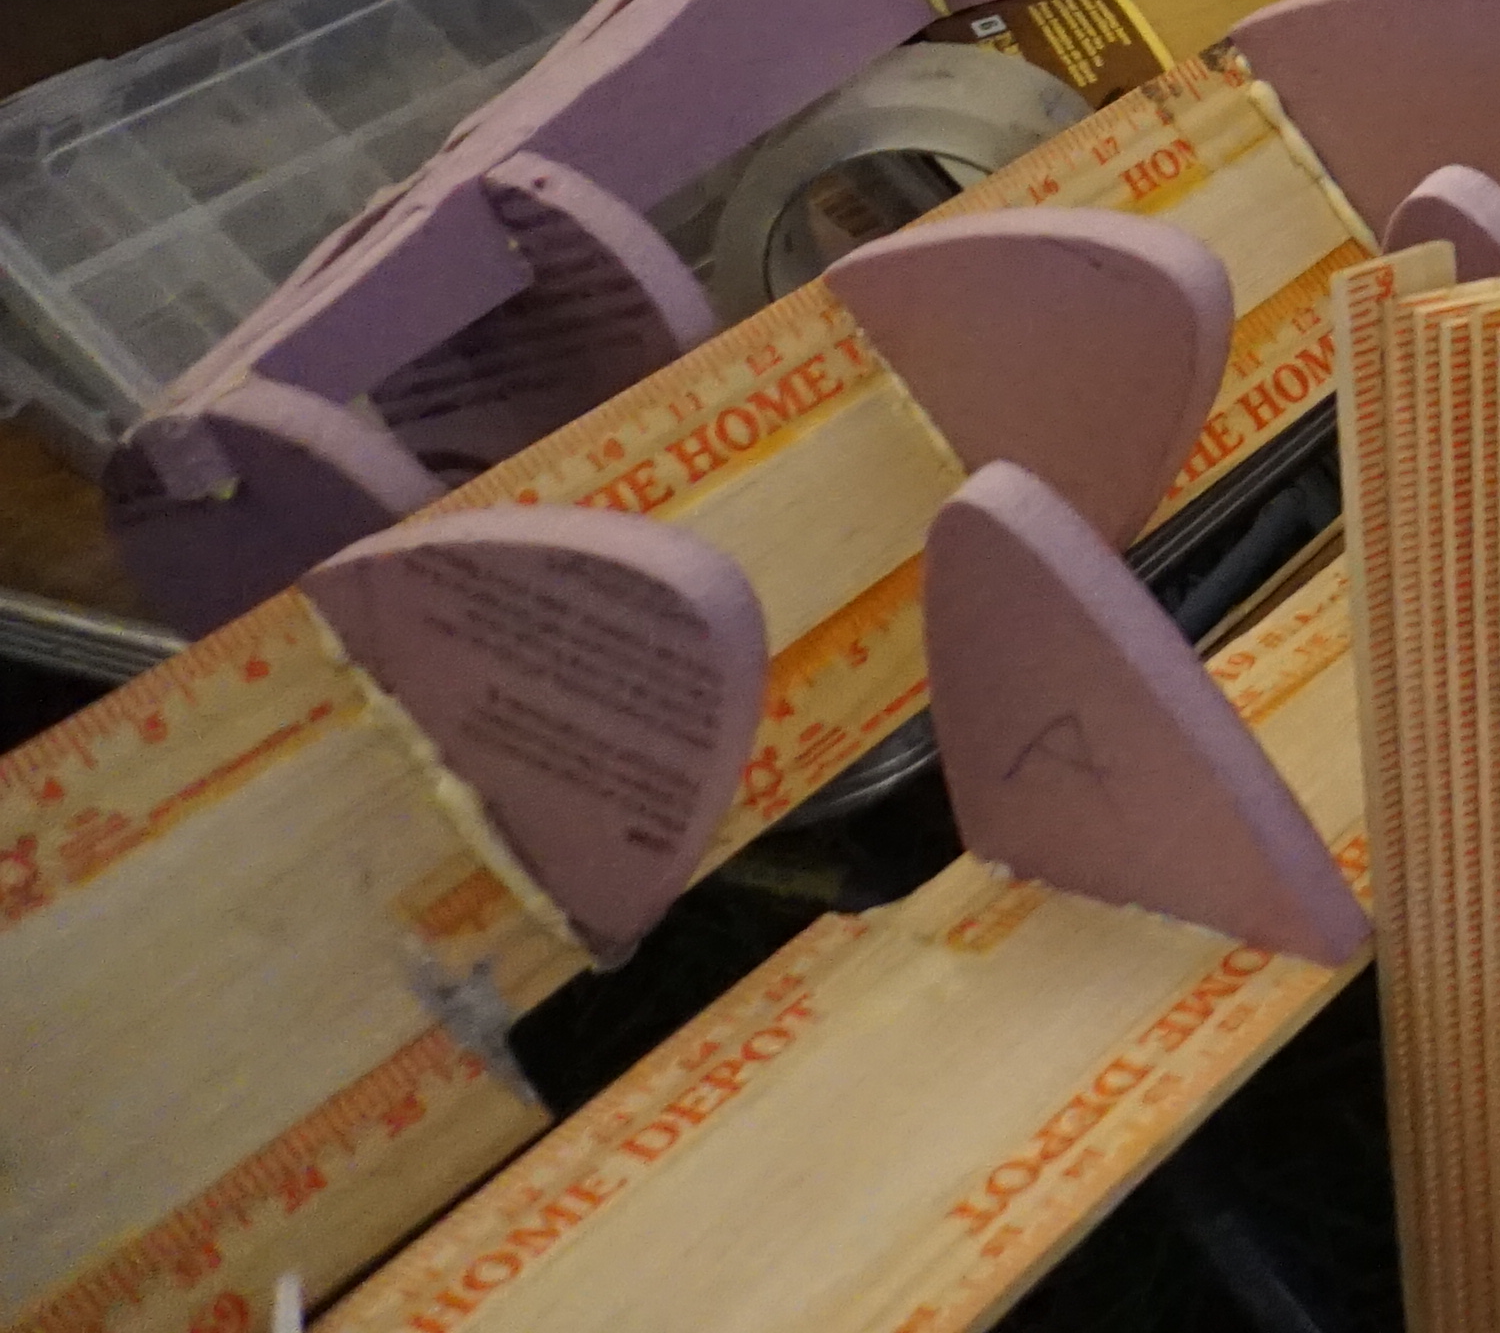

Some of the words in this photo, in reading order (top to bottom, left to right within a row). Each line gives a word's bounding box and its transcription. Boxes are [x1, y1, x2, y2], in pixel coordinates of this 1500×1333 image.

[666, 353, 845, 484] HOME
[746, 344, 782, 375] 12
[1234, 331, 1336, 432] HOM
[1138, 946, 1273, 1053] OME
[618, 992, 815, 1164] DEPOT
[946, 1056, 1154, 1236] DEPOT
